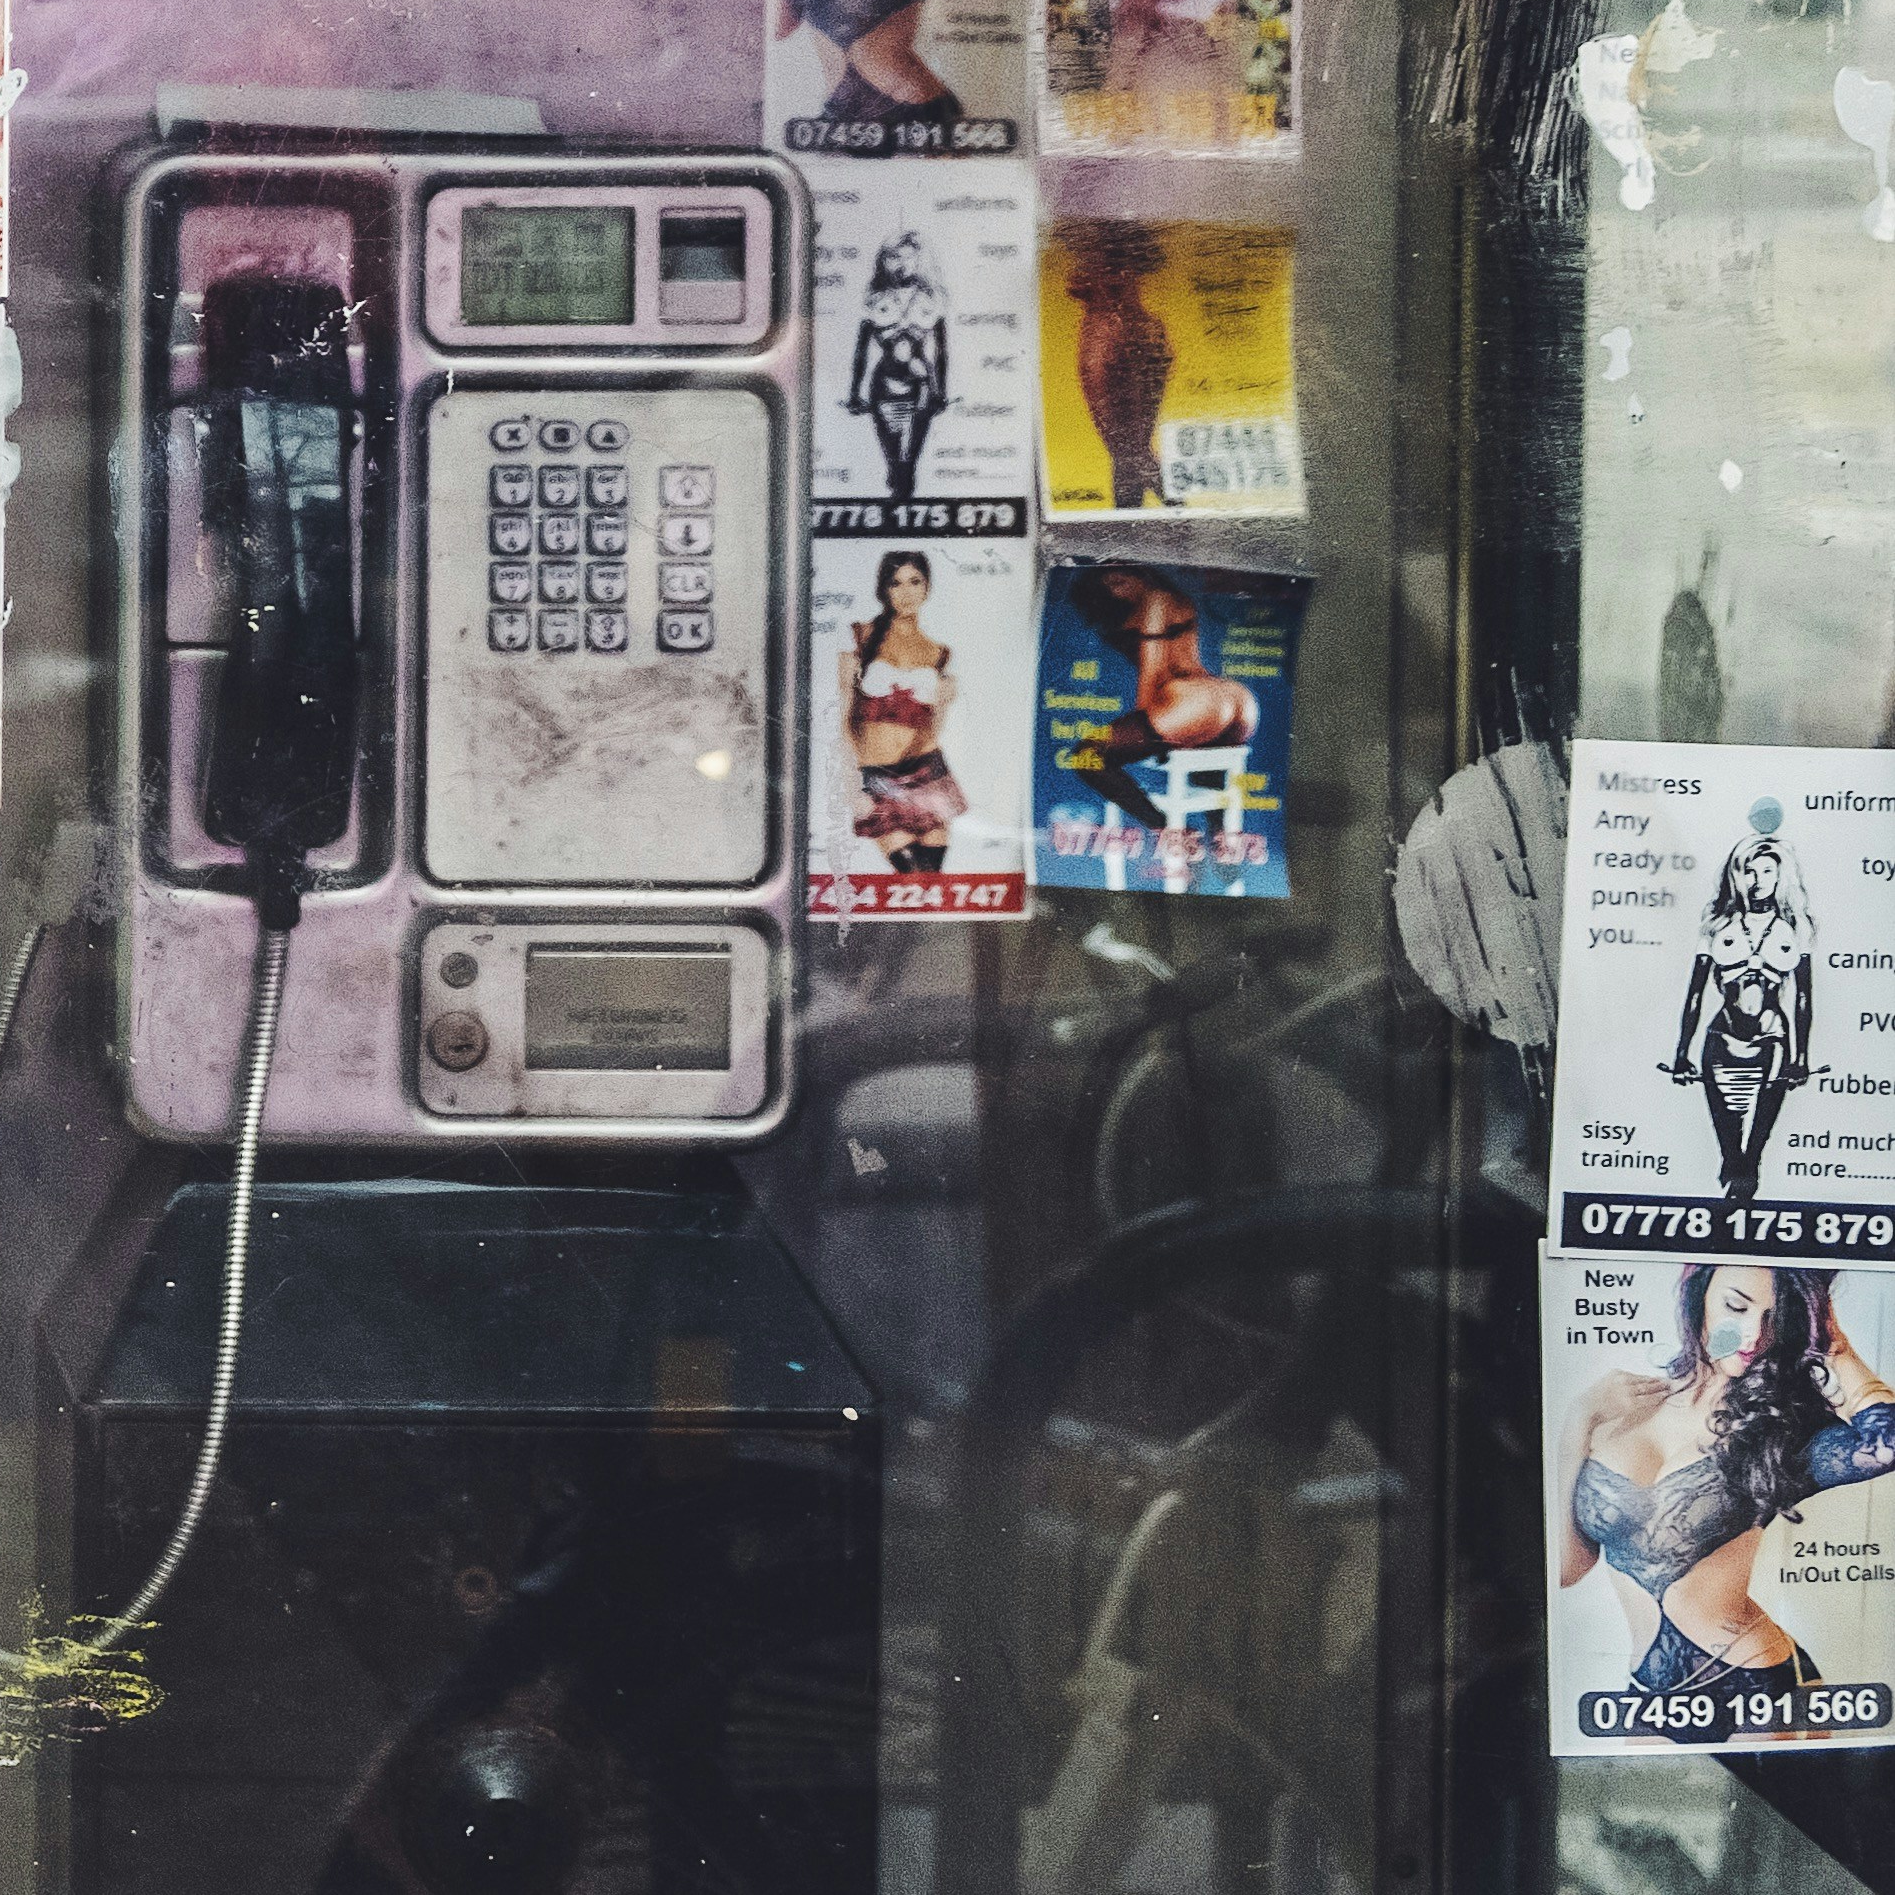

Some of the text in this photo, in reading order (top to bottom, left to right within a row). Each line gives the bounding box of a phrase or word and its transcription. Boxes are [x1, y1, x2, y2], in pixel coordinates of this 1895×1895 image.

[892, 505, 952, 528] 175
[956, 505, 1015, 529] 879
[666, 620, 704, 640] OK
[1598, 772, 1702, 797] Mistress
[1594, 811, 1651, 836] Amy
[1593, 850, 1697, 875] ready to
[887, 884, 1010, 908] 224 747
[1591, 888, 1677, 912] punish
[1828, 949, 1895, 972] canin
[1818, 1074, 1895, 1095] rubbe
[1581, 1121, 1636, 1146] sissy
[1787, 1130, 1832, 1151] and
[1581, 1150, 1670, 1176] training
[1581, 1203, 1894, 1247] 07778 175 879
[1584, 1269, 1635, 1288] New
[1575, 1298, 1640, 1320] Busty
[1566, 1327, 1655, 1345] in Town
[1793, 1539, 1881, 1558] 24 hours
[1779, 1564, 1895, 1585] In/Out Calls
[1593, 1688, 1880, 1731] 07459 191 566
